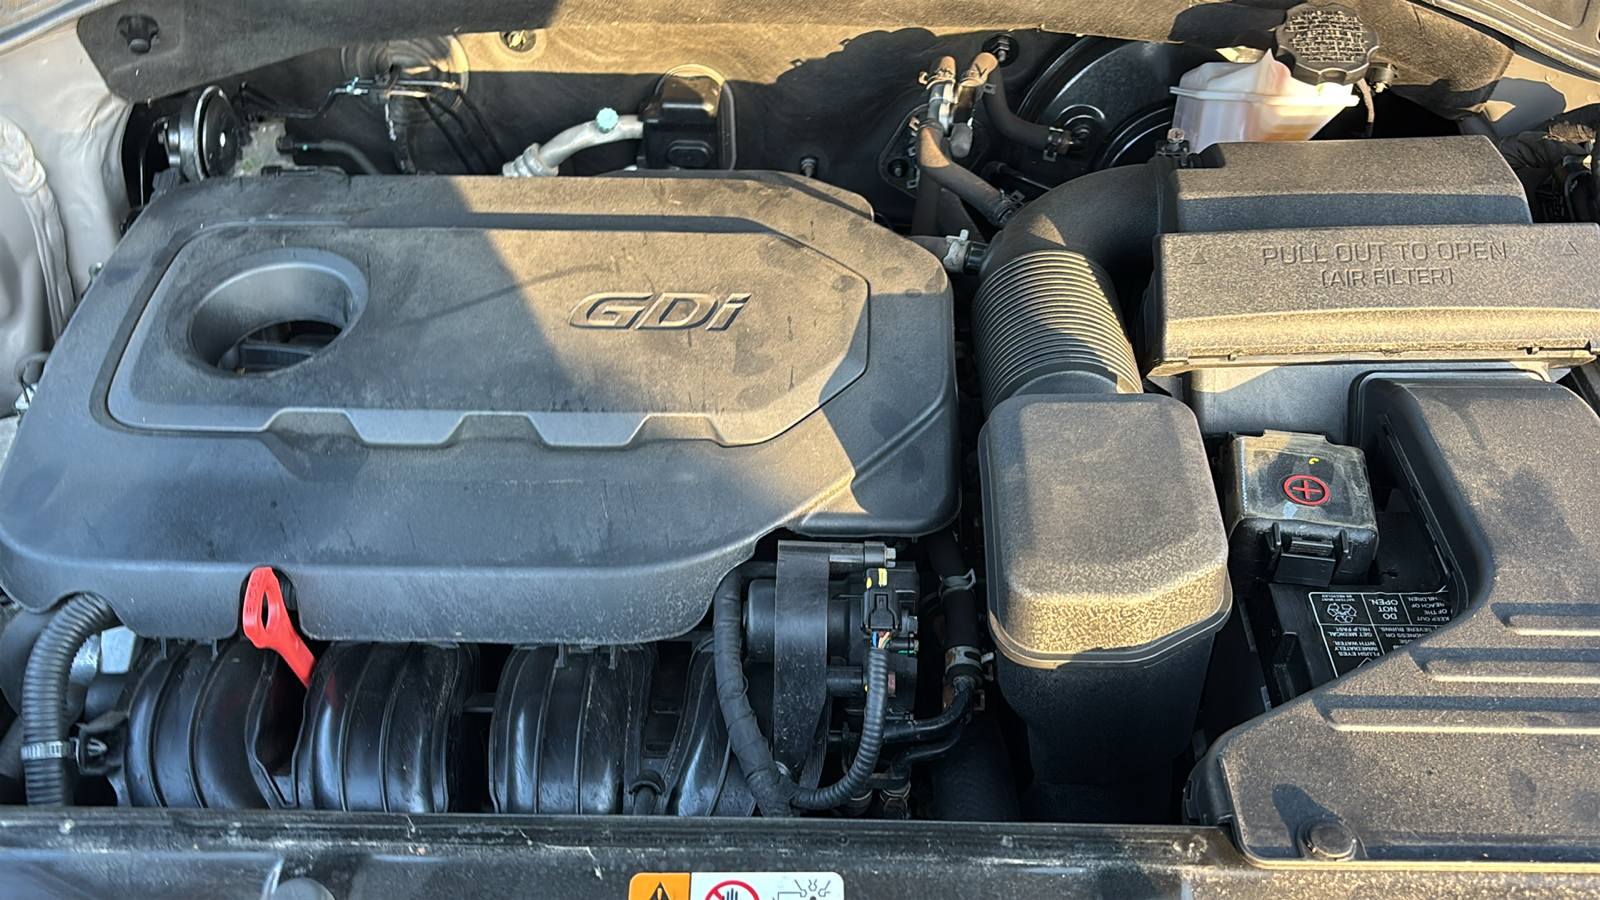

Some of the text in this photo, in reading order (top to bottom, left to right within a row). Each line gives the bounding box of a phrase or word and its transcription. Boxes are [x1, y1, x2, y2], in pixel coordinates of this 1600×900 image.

[1261, 239, 1507, 265] PULL OUT TO OPEN
[568, 292, 752, 331] GDi
